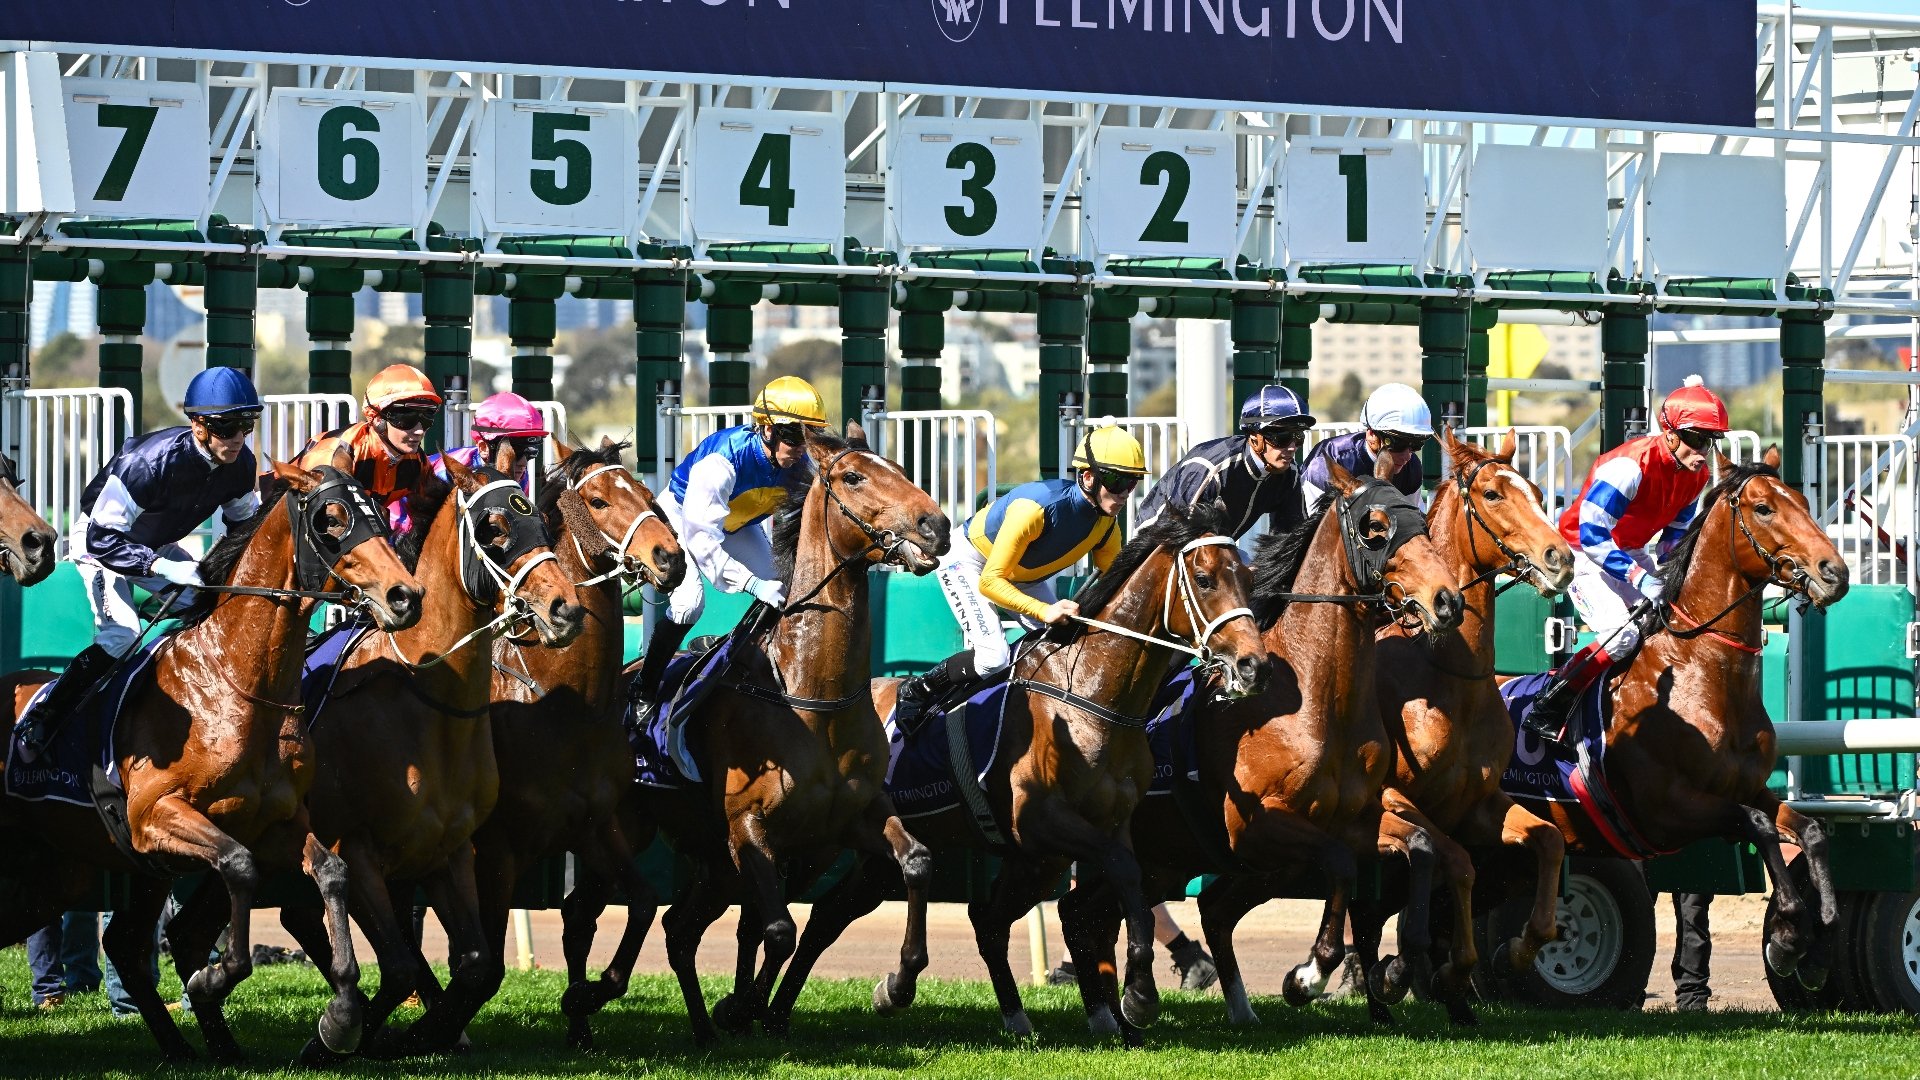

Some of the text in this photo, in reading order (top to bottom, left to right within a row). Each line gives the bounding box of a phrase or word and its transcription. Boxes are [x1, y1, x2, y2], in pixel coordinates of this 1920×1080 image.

[93, 103, 159, 201] 7
[318, 106, 380, 200] 6
[530, 108, 591, 205] 5
[740, 133, 795, 226] 4
[944, 142, 997, 236] 3
[1138, 151, 1190, 243] 2
[1339, 155, 1367, 242] 1
[96, 576, 105, 592] THE
[957, 574, 990, 637] OFF THE TRACK
